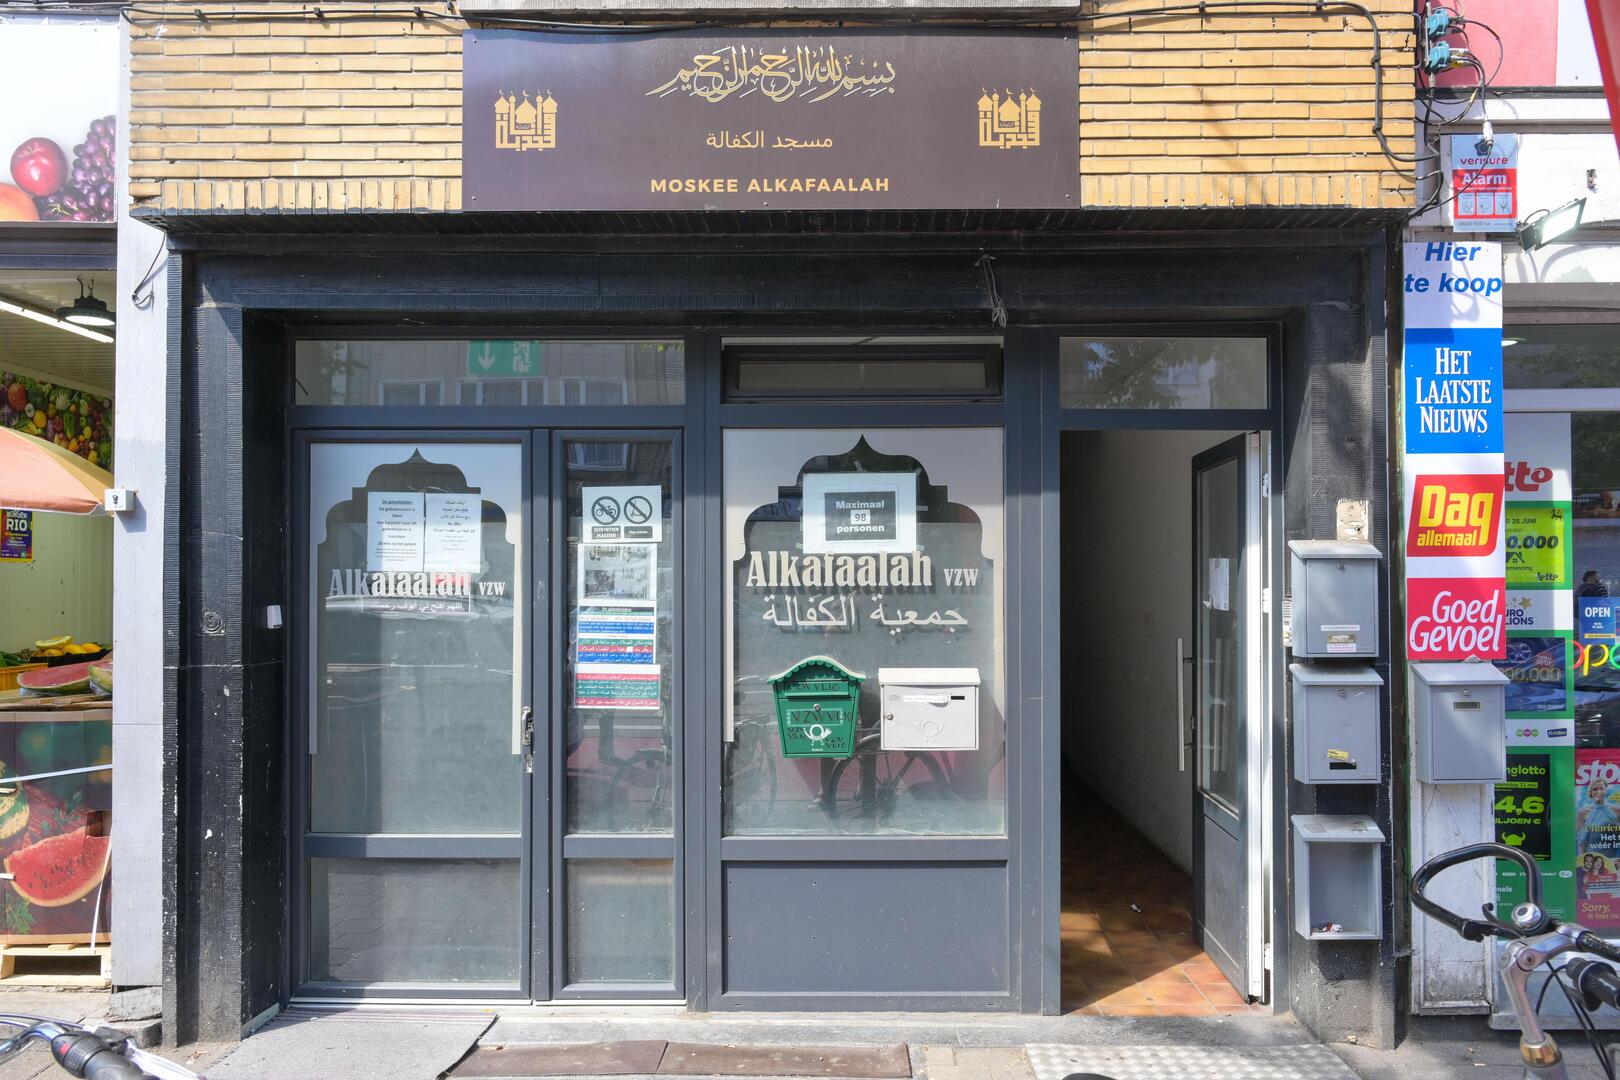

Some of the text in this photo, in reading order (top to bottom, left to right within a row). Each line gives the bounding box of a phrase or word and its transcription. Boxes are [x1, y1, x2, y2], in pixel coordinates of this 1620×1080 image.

[706, 132, 833, 149] مسجد الكفالة
[1460, 157, 1508, 165] verisure
[650, 177, 890, 193] MOSKEE ALKAFAALAH
[1462, 172, 1507, 185] Alarm
[1425, 241, 1482, 262] Hier
[1404, 273, 1503, 297] te koop
[1435, 347, 1472, 375] HET
[1415, 377, 1492, 405] LAATSTE
[1419, 406, 1489, 434] NIEUWS
[836, 500, 885, 510] Maximaal
[854, 513, 867, 522] 98
[1419, 485, 1495, 546] Dag
[6, 518, 28, 532] RIO
[836, 525, 885, 534] personen
[1416, 529, 1478, 547] allemaal
[746, 550, 933, 587] Alkafaalah
[762, 590, 968, 636] جمعية الكفالة
[1432, 589, 1500, 624] Goed
[1584, 606, 1611, 618] OPEN
[1409, 614, 1503, 652] Gevoel
[1494, 795, 1545, 816] 4,6
[1600, 833, 1617, 841] Het
[1582, 902, 1610, 914] Sorry,
